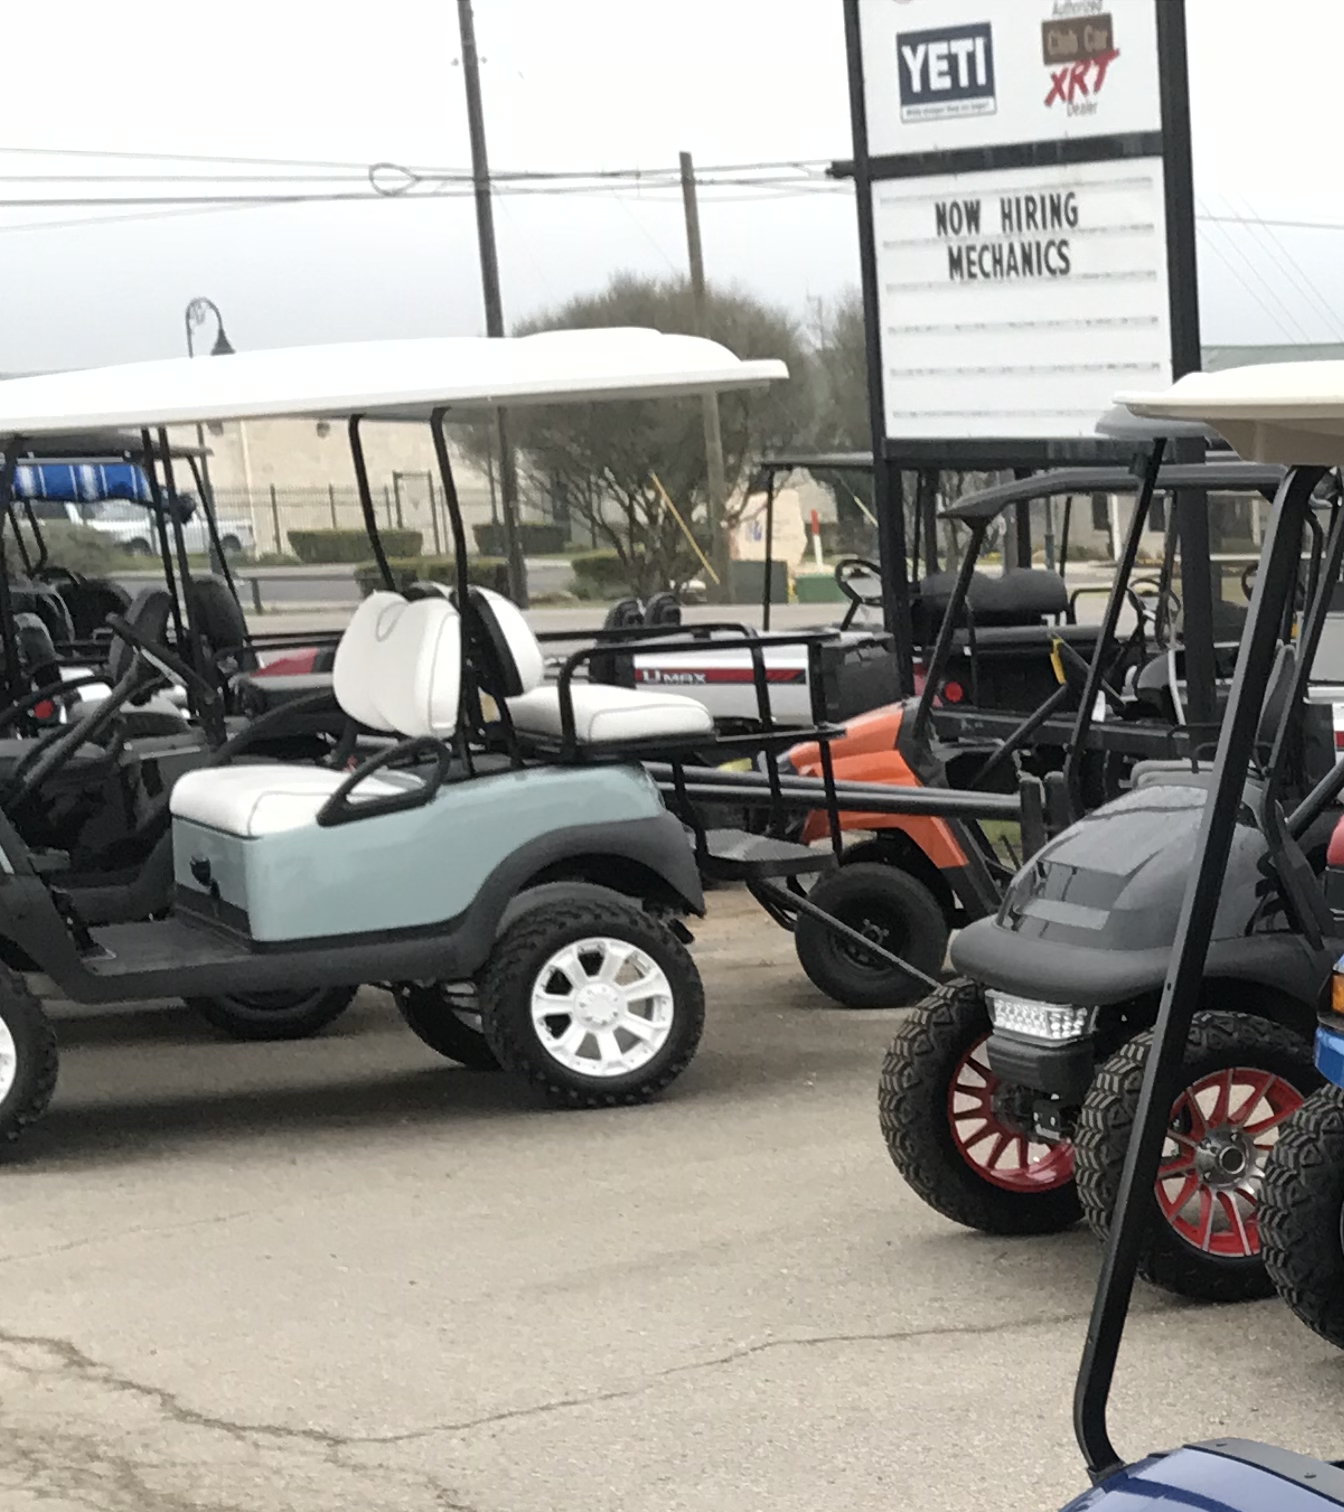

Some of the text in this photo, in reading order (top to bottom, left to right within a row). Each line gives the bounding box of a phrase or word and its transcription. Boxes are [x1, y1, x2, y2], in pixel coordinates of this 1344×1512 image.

[901, 37, 987, 93] YETI
[1044, 48, 1120, 107] XRT
[935, 191, 1079, 237] NOW HIRING
[949, 238, 1071, 281] MECHANICS
